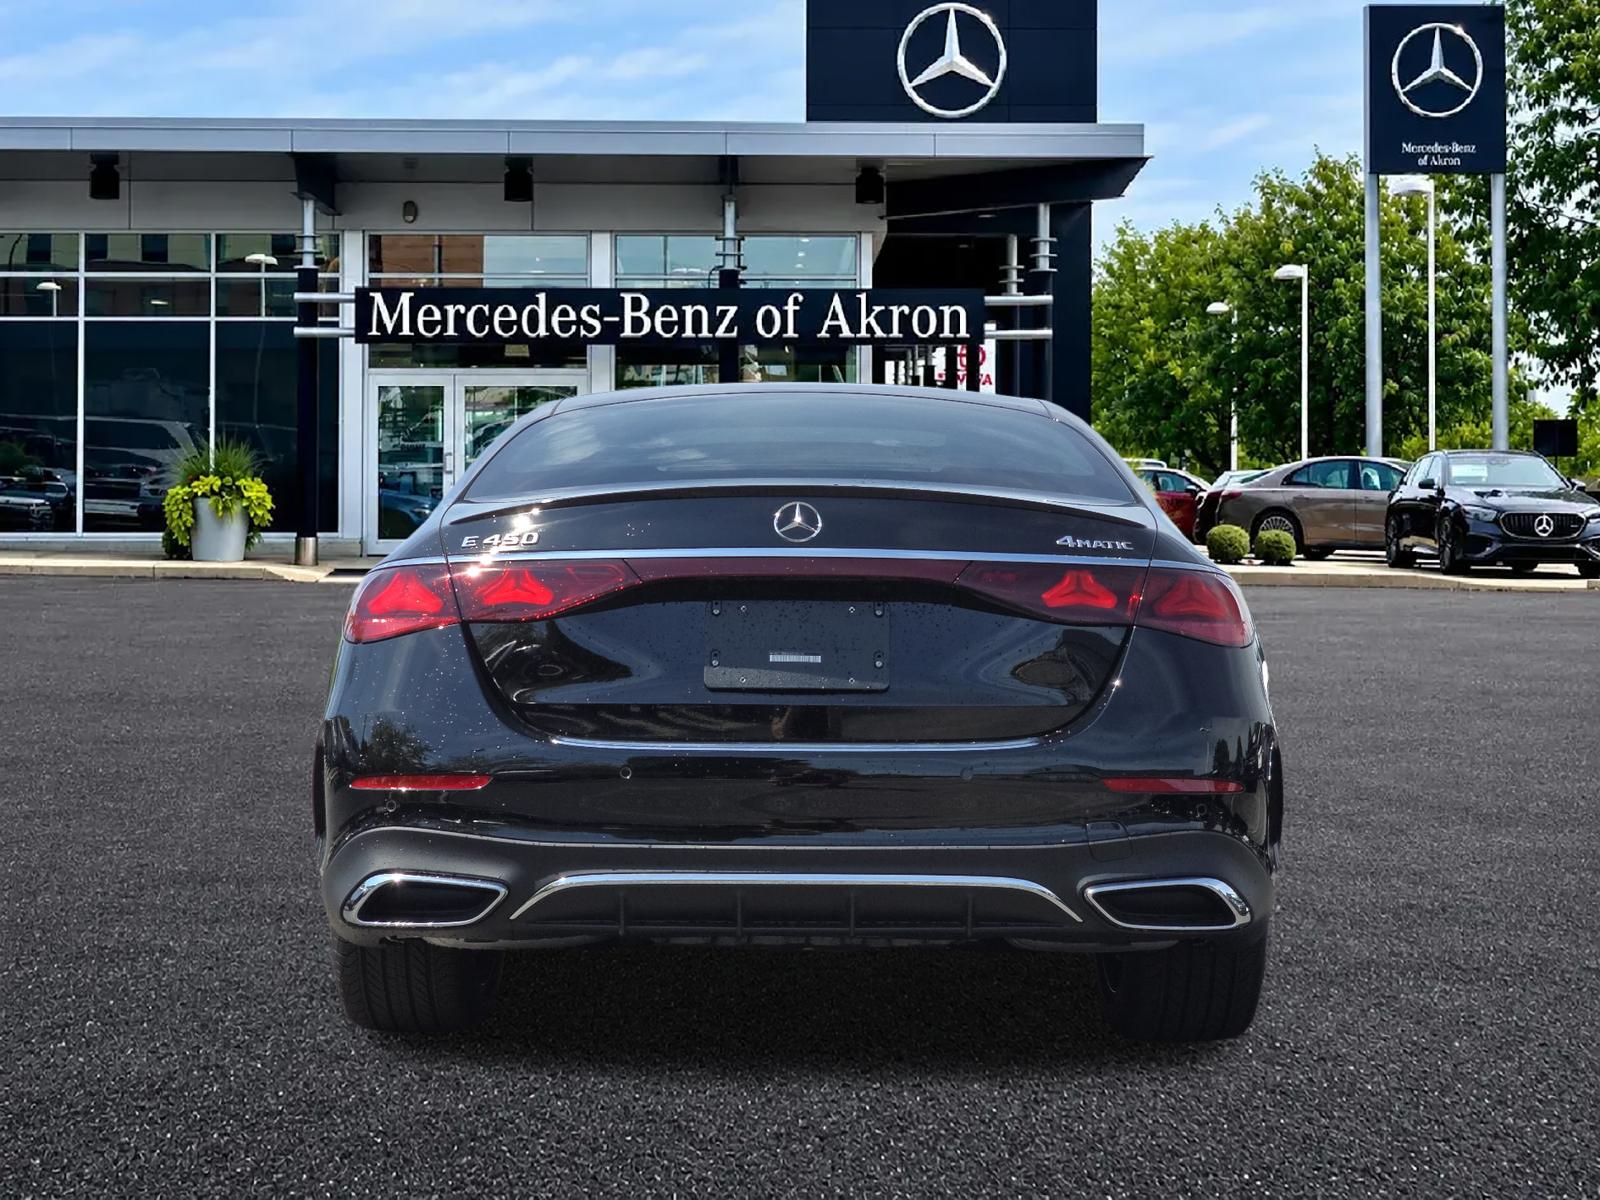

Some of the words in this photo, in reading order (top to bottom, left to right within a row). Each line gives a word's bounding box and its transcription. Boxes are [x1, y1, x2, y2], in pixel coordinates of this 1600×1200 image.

[1401, 142, 1476, 153] Mercedes-Benz
[1417, 154, 1428, 166] of
[1430, 154, 1460, 166] Akron
[367, 292, 738, 338] Mercedes-Benz
[756, 293, 804, 338] of
[817, 292, 970, 338] Akron
[461, 535, 479, 548] E
[482, 532, 539, 547] 450
[1056, 535, 1134, 550] 4MATIC
